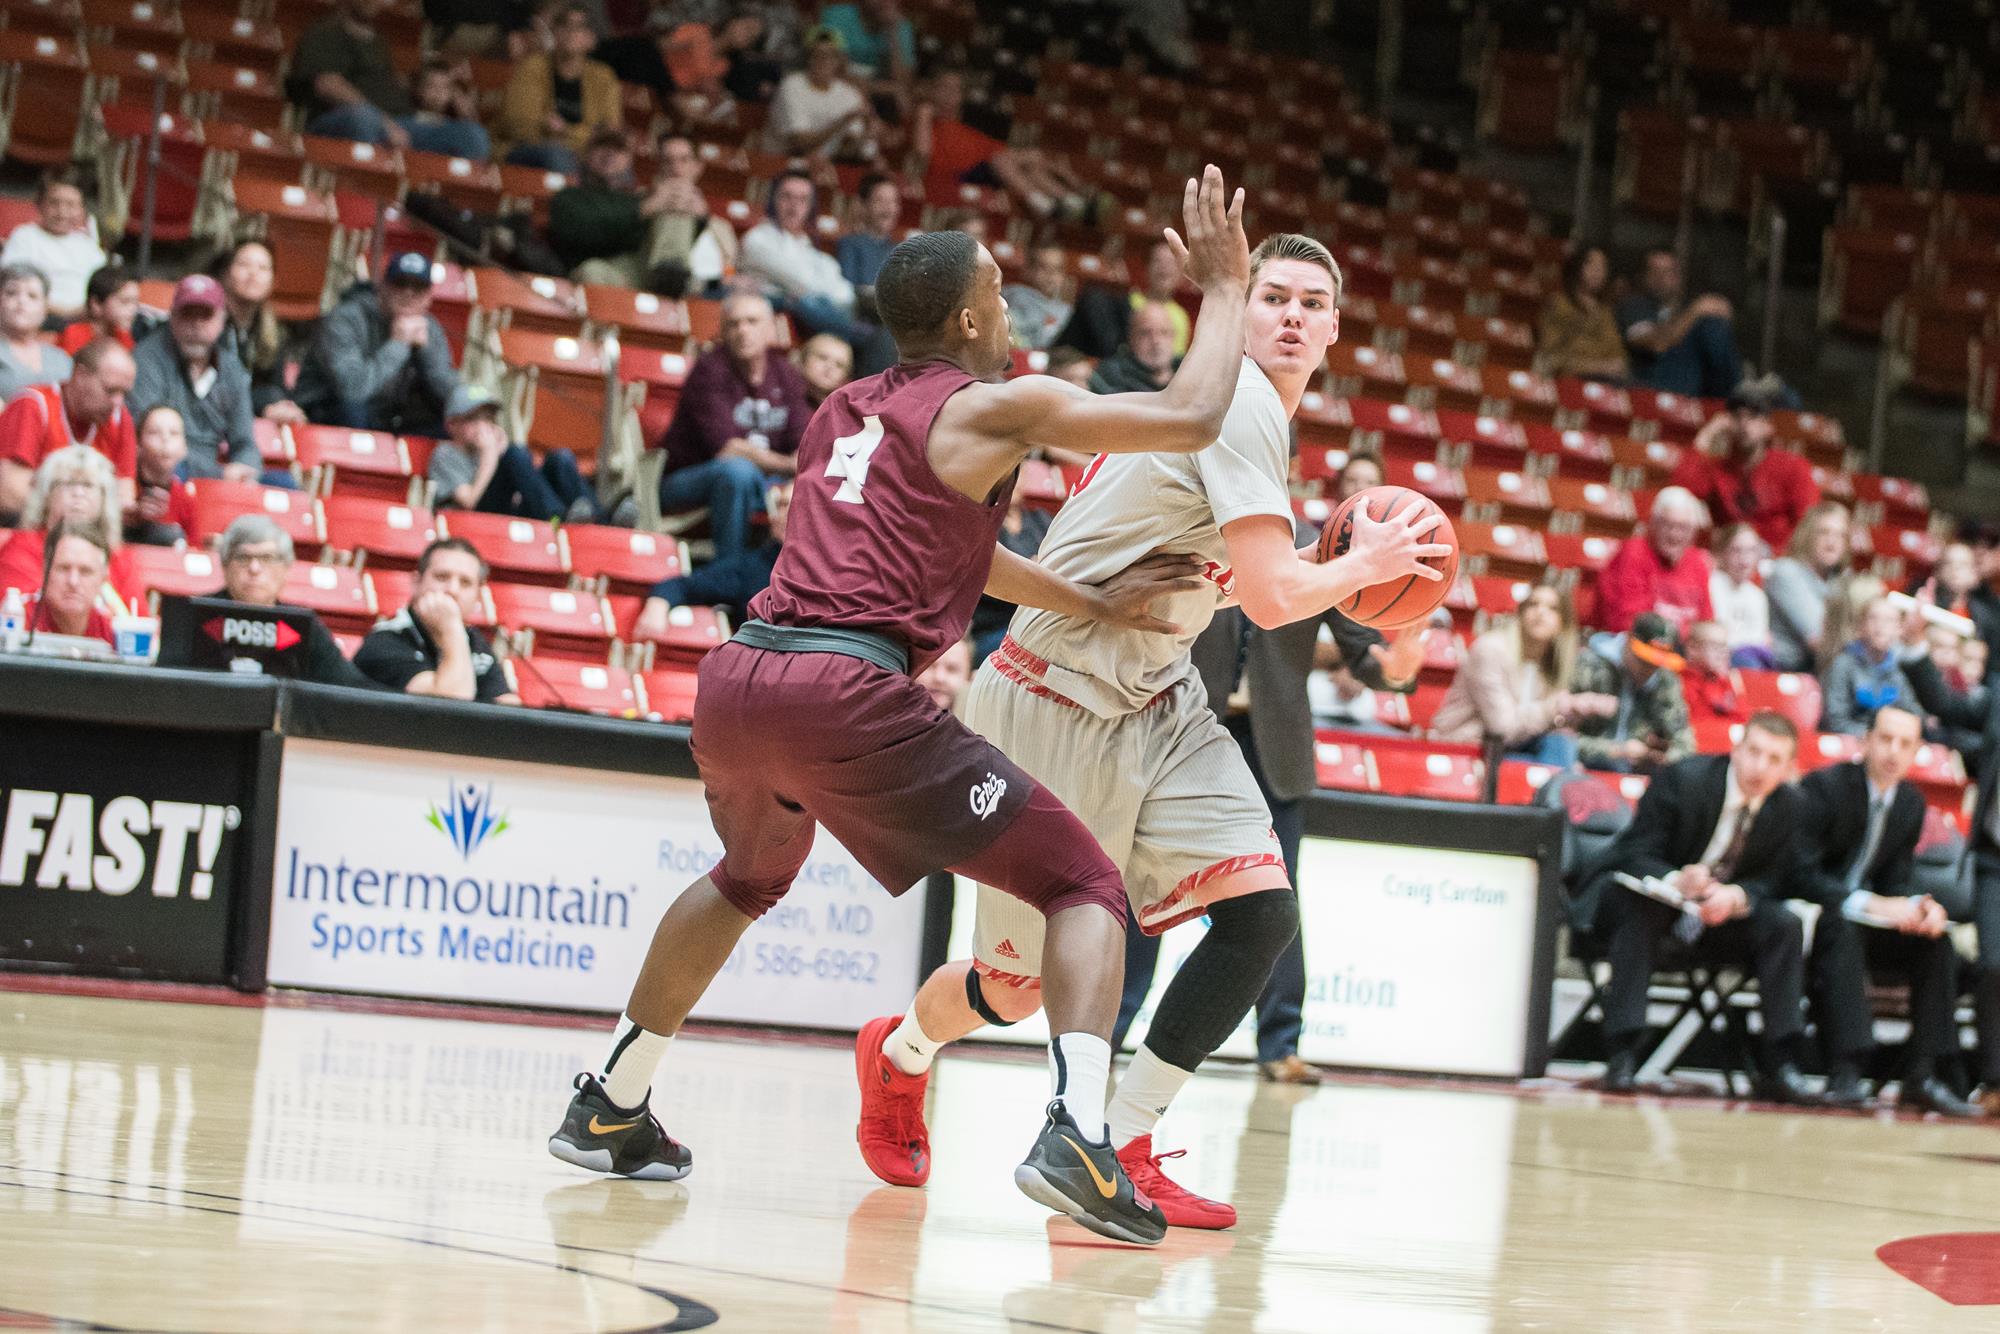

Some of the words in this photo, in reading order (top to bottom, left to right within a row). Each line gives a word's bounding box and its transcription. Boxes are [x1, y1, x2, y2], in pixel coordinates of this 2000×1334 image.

[824, 415, 885, 504] 4
[223, 617, 277, 648] POSS
[287, 846, 631, 928] Intermountain
[827, 902, 874, 936] MD
[311, 912, 425, 959] Sports
[438, 922, 596, 972] Medicine
[754, 941, 881, 984] 586-6962
[1307, 963, 1398, 1008] ation
